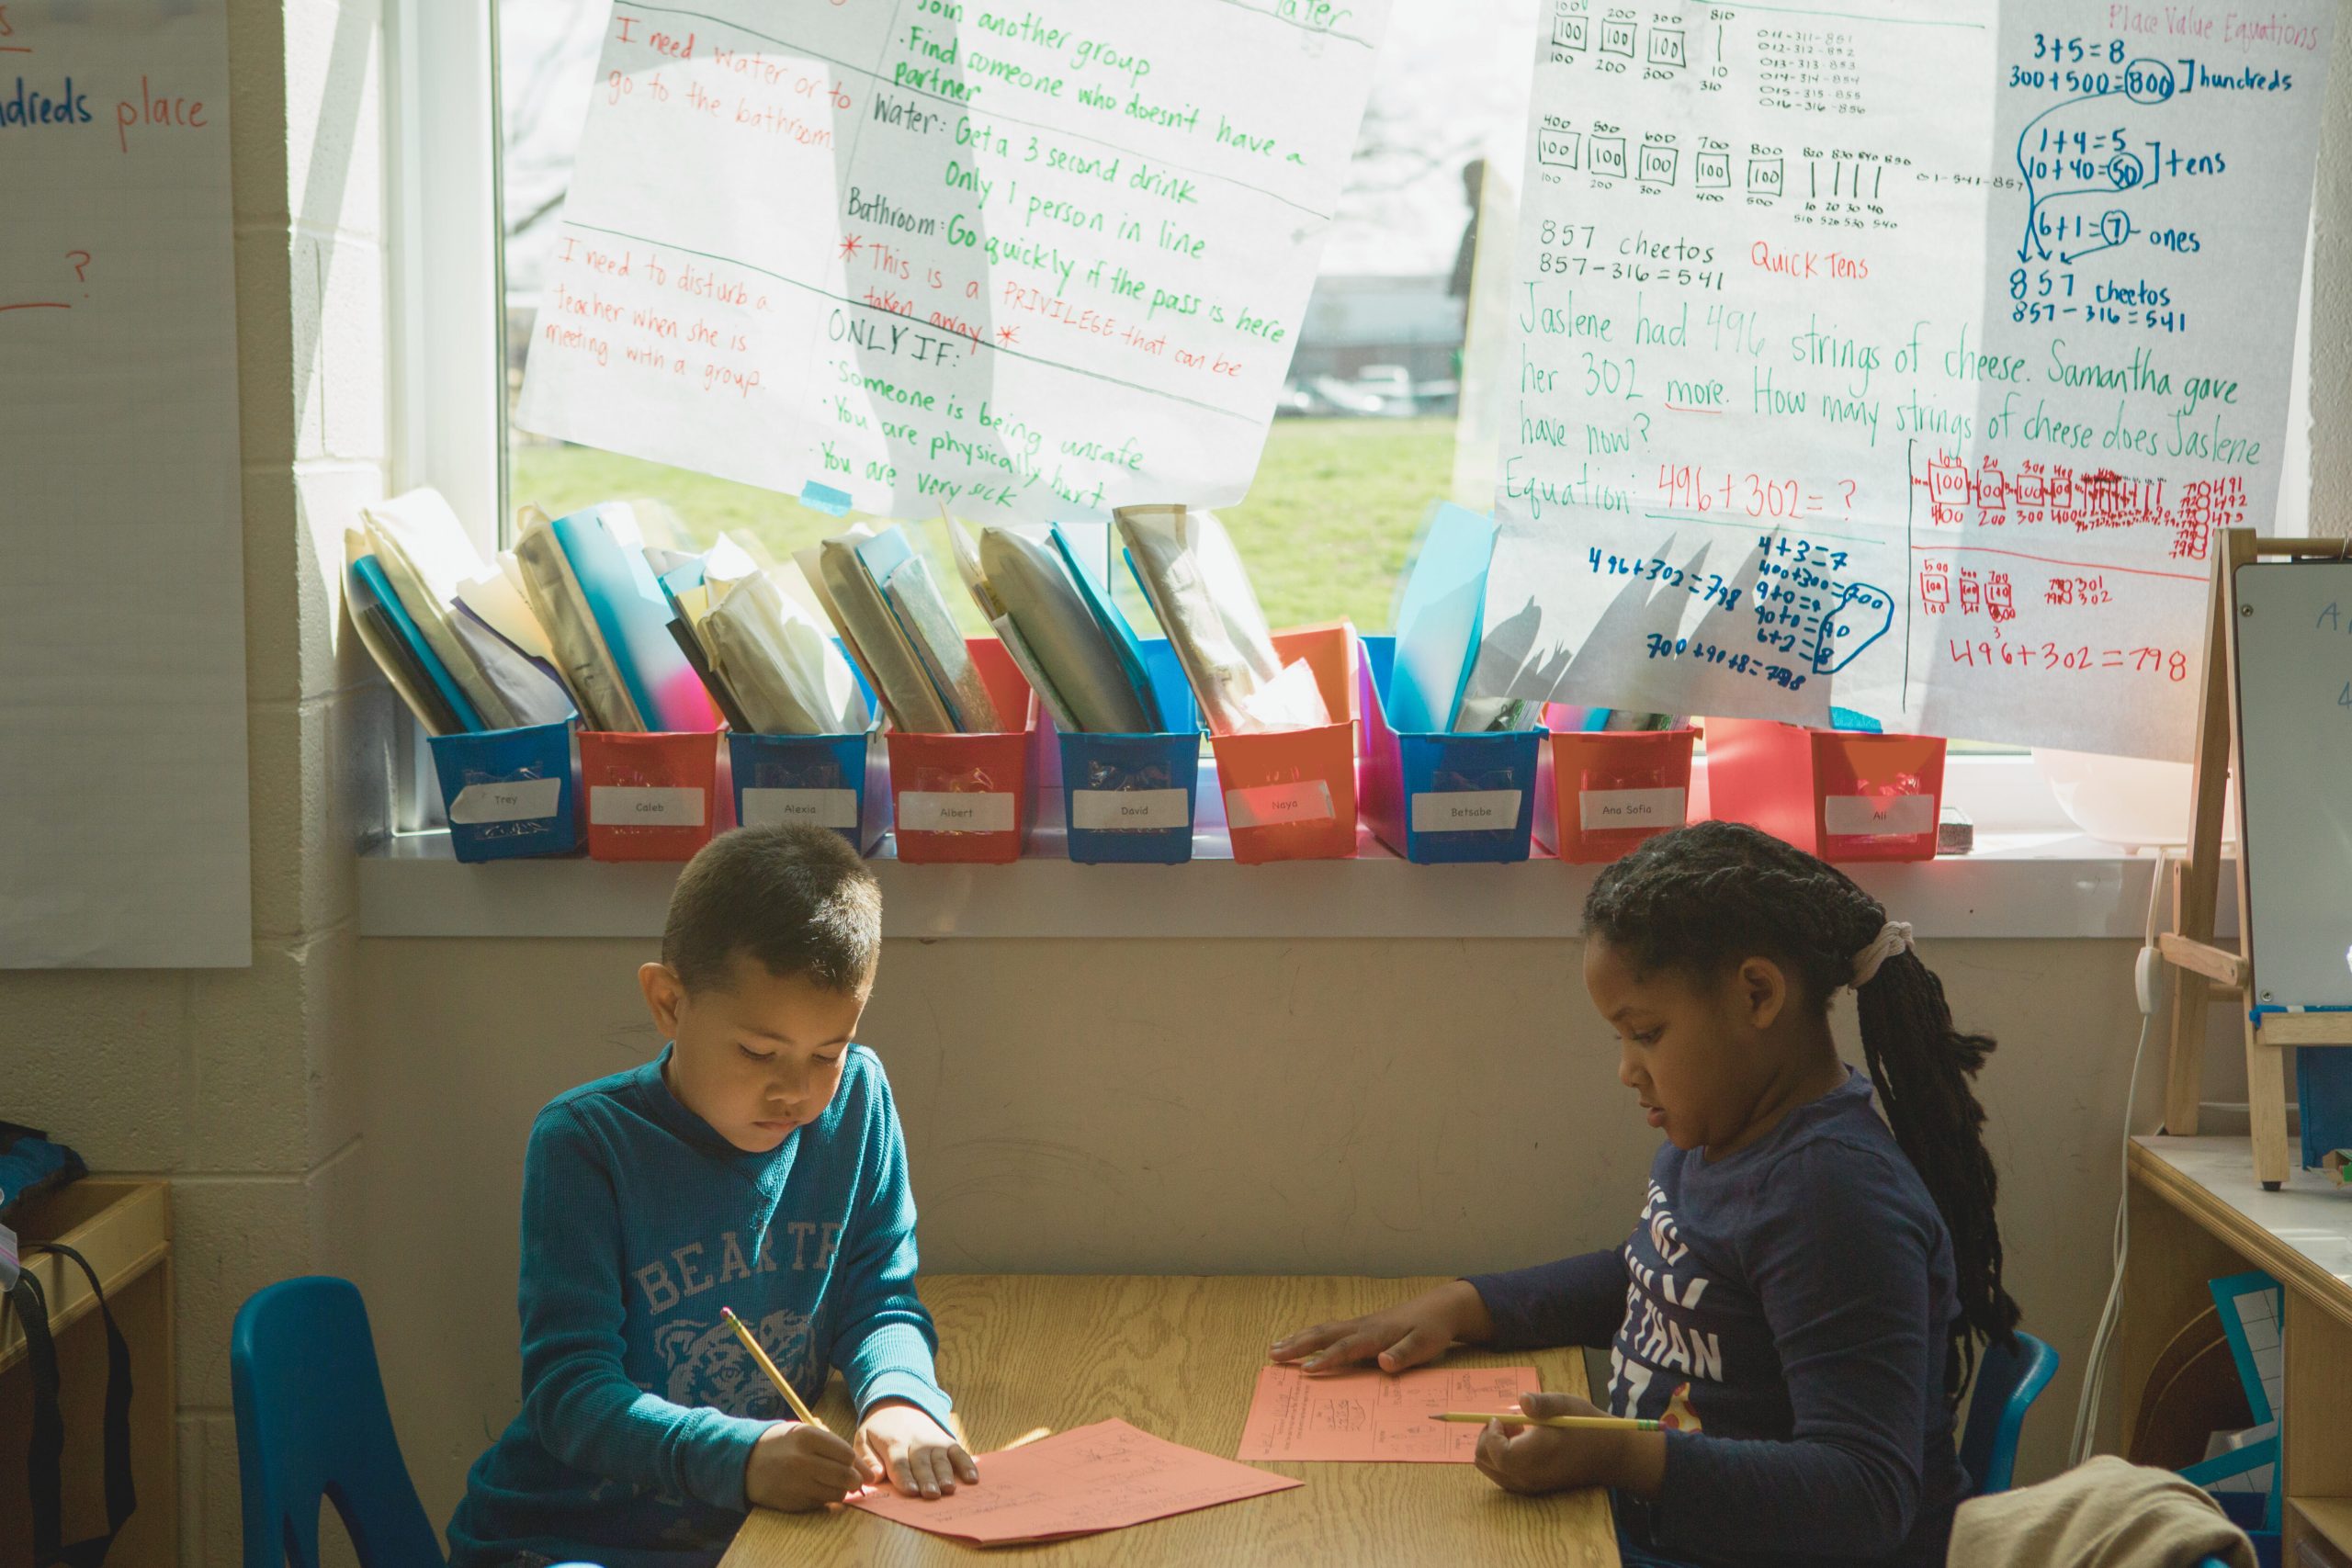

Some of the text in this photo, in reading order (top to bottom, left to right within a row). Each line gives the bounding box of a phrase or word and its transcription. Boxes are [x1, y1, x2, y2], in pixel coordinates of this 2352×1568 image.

[978, 12, 1071, 51] another
[1070, 39, 1150, 88] group
[2109, 5, 2318, 53] Place Value Equations
[616, 17, 640, 43] I
[650, 33, 695, 59] need
[795, 77, 820, 98] or
[827, 81, 851, 109] to
[893, 61, 982, 102] partner
[2199, 66, 2293, 92] hundreds
[117, 75, 208, 153] place
[608, 70, 633, 106] go
[648, 73, 669, 102] to
[685, 82, 721, 118] the
[967, 51, 1064, 97] someone
[1078, 84, 1117, 110] who
[1216, 114, 1276, 156] have
[1285, 151, 1308, 166] a
[1023, 137, 1040, 162] 3
[1046, 149, 1120, 183] second
[2165, 149, 2226, 178] tens
[944, 161, 994, 210] Only
[1026, 195, 1105, 232] person
[1117, 212, 1141, 243] in
[1159, 220, 1206, 259] line
[1540, 220, 1595, 250] 857
[2149, 229, 2200, 253] ones
[65, 250, 91, 299] ?
[558, 236, 775, 313] I need to disturb a
[947, 214, 977, 247] Go
[983, 236, 1075, 297] quickly
[1111, 267, 1147, 300] the
[1147, 288, 1203, 321] pass
[1208, 299, 1226, 324] is
[1235, 306, 1286, 344] here
[1824, 251, 1869, 280] Tens
[550, 282, 747, 353] teacher when she is
[863, 285, 914, 318] taken
[926, 259, 944, 290] is
[965, 280, 980, 301] a
[1121, 324, 1167, 355] that
[1174, 348, 1206, 371] can
[1211, 352, 1244, 378] be
[545, 321, 685, 376] meeting with a
[829, 308, 910, 355] ONLY
[1635, 291, 1687, 347] had
[1706, 305, 1766, 356] 496
[1791, 312, 1881, 399] strings
[1894, 320, 1931, 374] of
[2047, 338, 2173, 397] Samantha
[2183, 377, 2239, 417] gave
[1521, 344, 1559, 394] her
[1582, 352, 1644, 401] 302
[1753, 366, 1806, 416] How
[1823, 395, 1880, 447] many
[1895, 389, 1972, 460] strings
[1987, 391, 2022, 440] of
[2023, 398, 2093, 449] cheese
[2101, 399, 2158, 457] does
[945, 394, 965, 421] is
[978, 401, 1043, 457] being
[1060, 436, 1146, 472] unsafe
[1520, 400, 1651, 456] have now?
[865, 461, 899, 489] are
[967, 481, 1018, 508] sick
[881, 421, 919, 446] are
[930, 432, 1043, 490] physically
[1049, 463, 1108, 511] hurt
[495, 795, 518, 806] Trey
[636, 802, 664, 813] Caleb
[784, 804, 817, 815] Alexia
[940, 807, 974, 818] Albert
[1121, 806, 1149, 817] David
[1272, 800, 1299, 813] Naya
[1450, 807, 1493, 818] Betsabe
[1601, 804, 1653, 816] Ana Sofia
[1872, 810, 1887, 821] Ali
